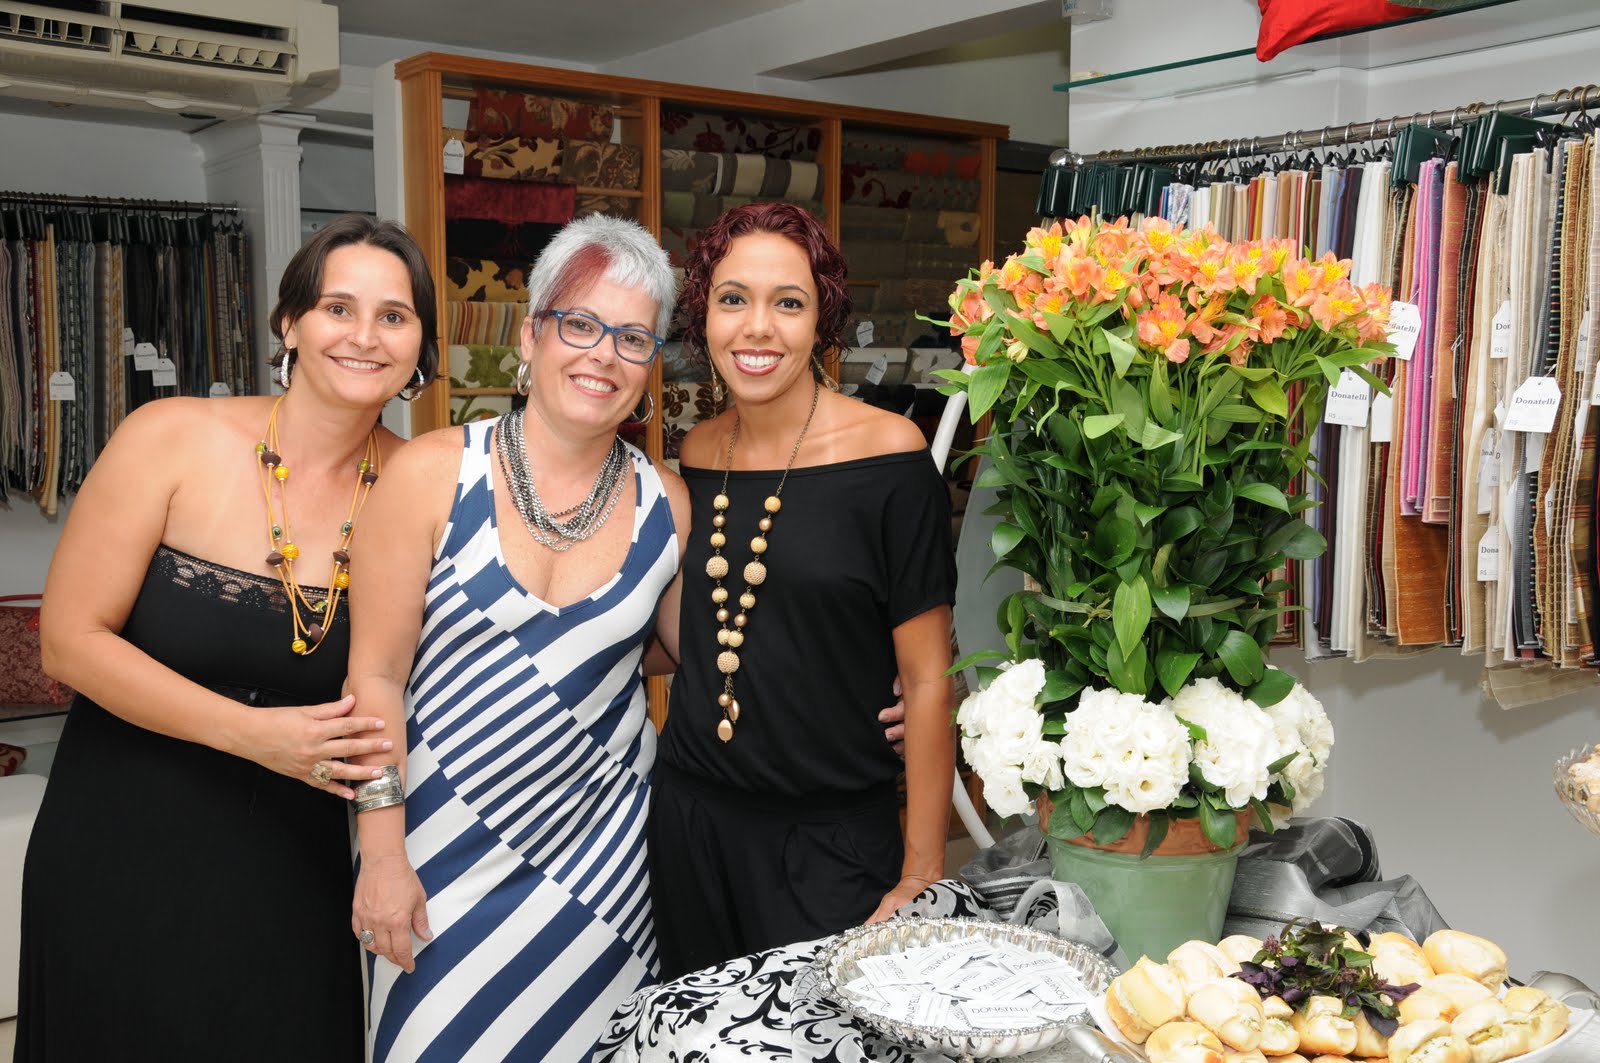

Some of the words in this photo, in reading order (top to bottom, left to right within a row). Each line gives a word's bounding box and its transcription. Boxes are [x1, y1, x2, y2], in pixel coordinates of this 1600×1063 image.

[1330, 390, 1368, 401] Donatelli
[1515, 396, 1556, 405] Donatelli
[971, 1005, 1031, 1014] DONATELLI
